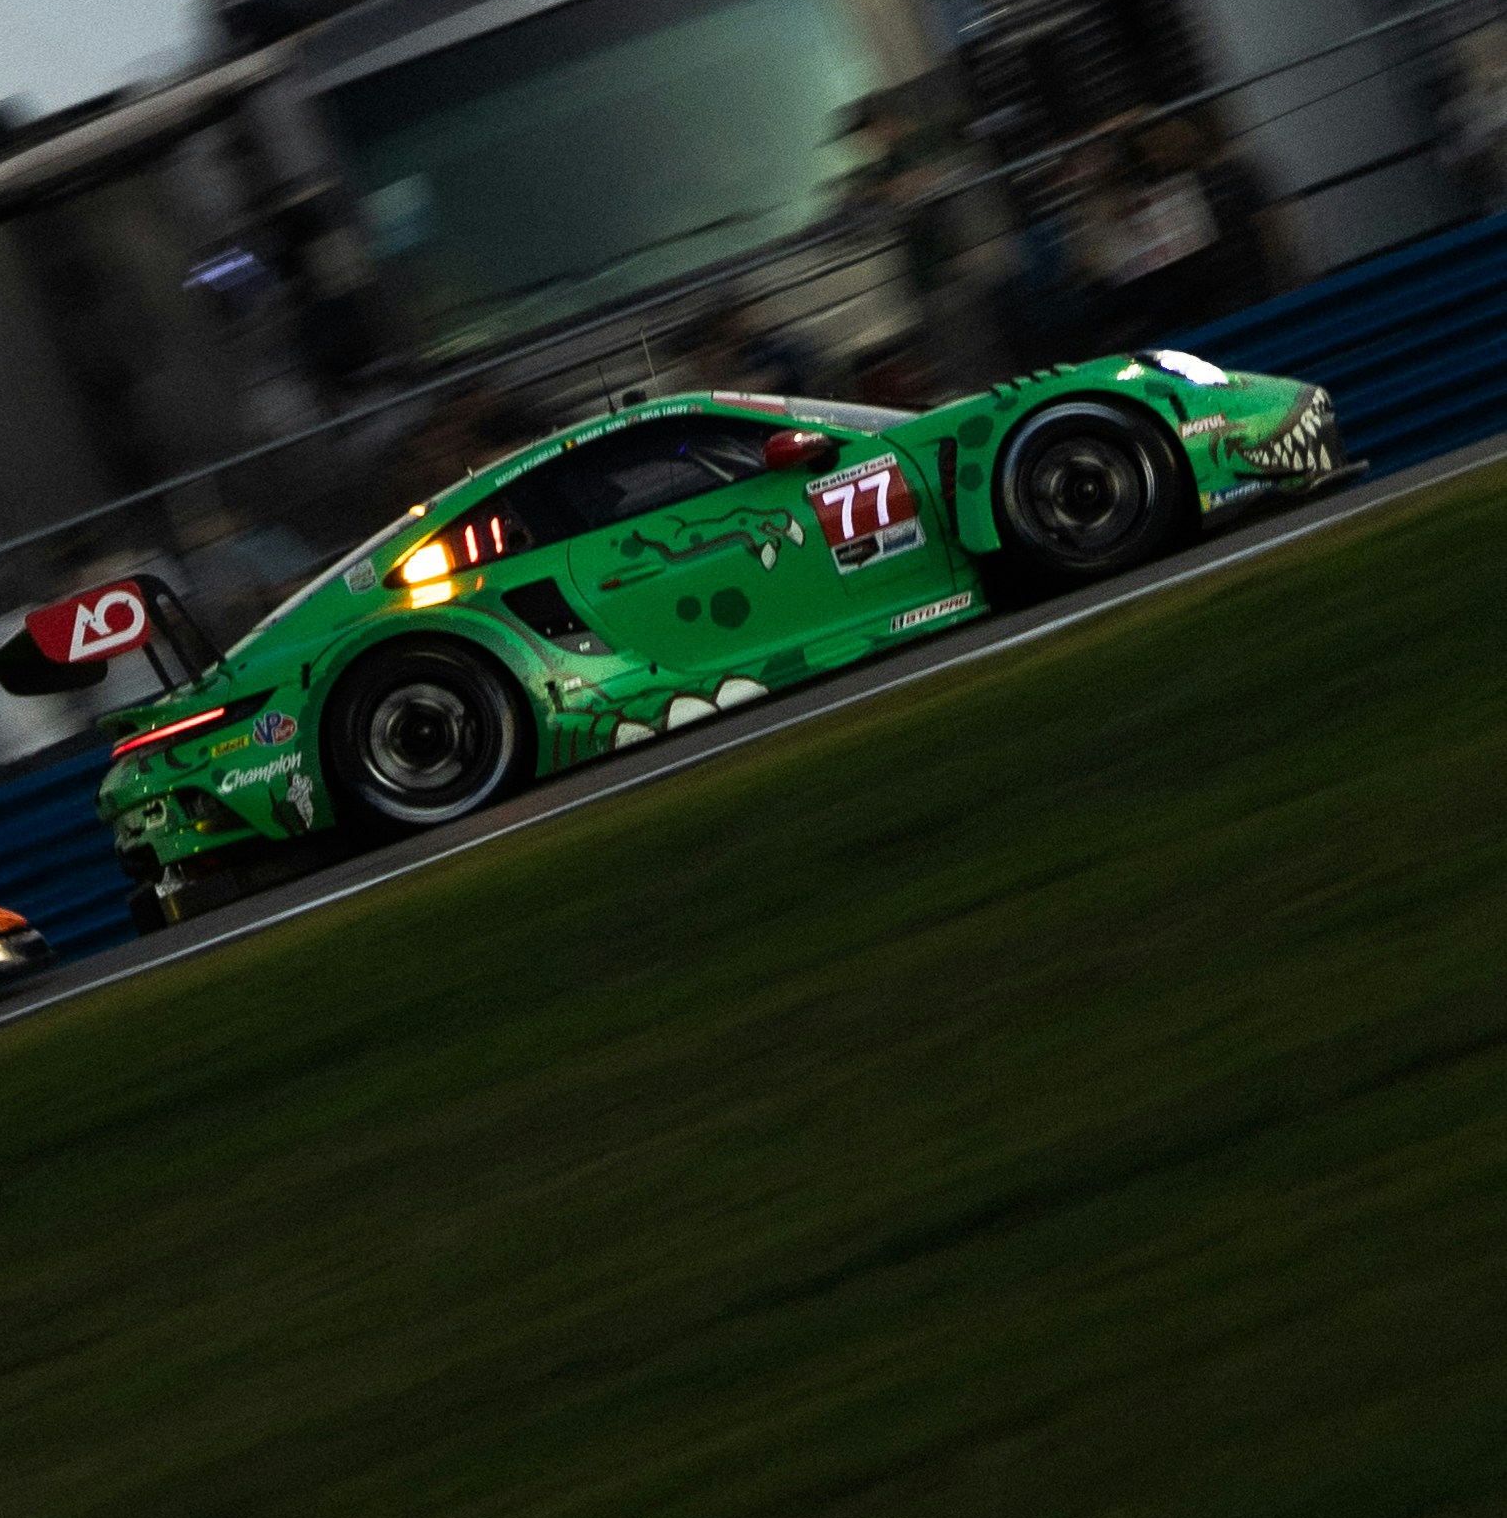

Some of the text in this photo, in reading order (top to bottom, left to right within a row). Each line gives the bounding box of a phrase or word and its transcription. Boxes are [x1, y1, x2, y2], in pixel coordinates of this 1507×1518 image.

[1182, 414, 1225, 438] MOTUL
[808, 456, 894, 491] WeatherTech
[822, 470, 891, 541] 77
[217, 751, 303, 795] Champion
